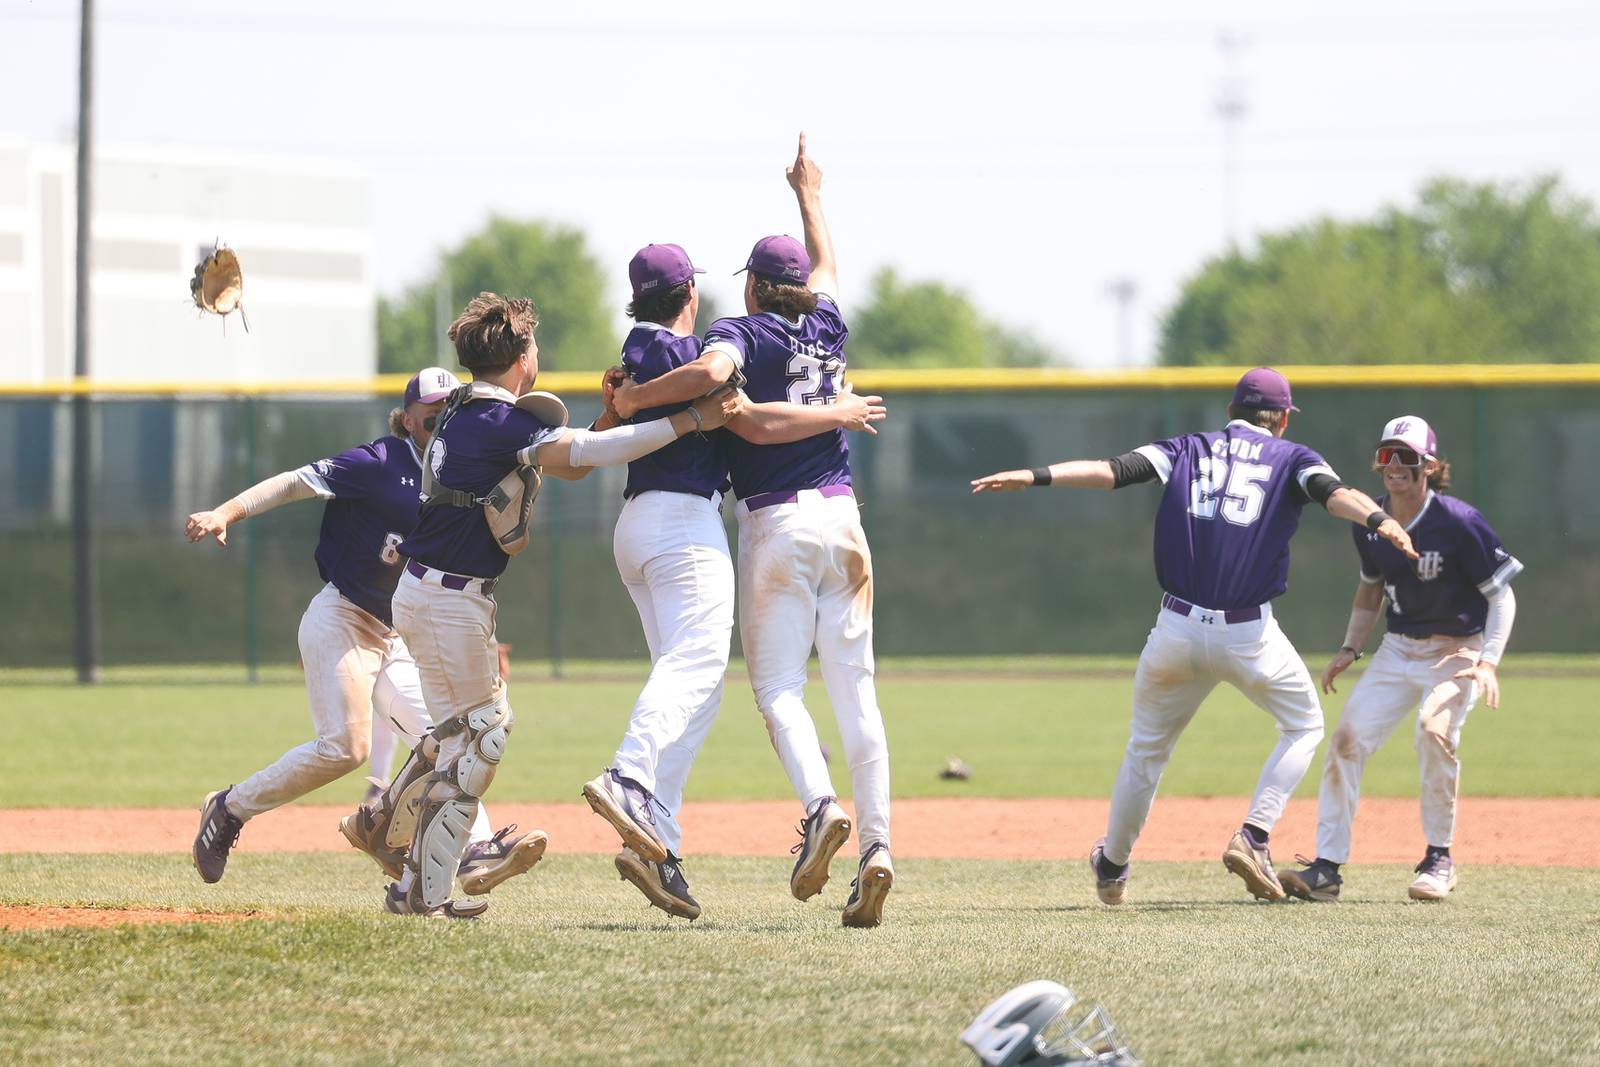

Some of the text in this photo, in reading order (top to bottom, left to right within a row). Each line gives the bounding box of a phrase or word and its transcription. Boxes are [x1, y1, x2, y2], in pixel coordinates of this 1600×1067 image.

[1211, 438, 1264, 461] STURM
[1188, 455, 1273, 528] 25
[380, 532, 404, 565] 8
